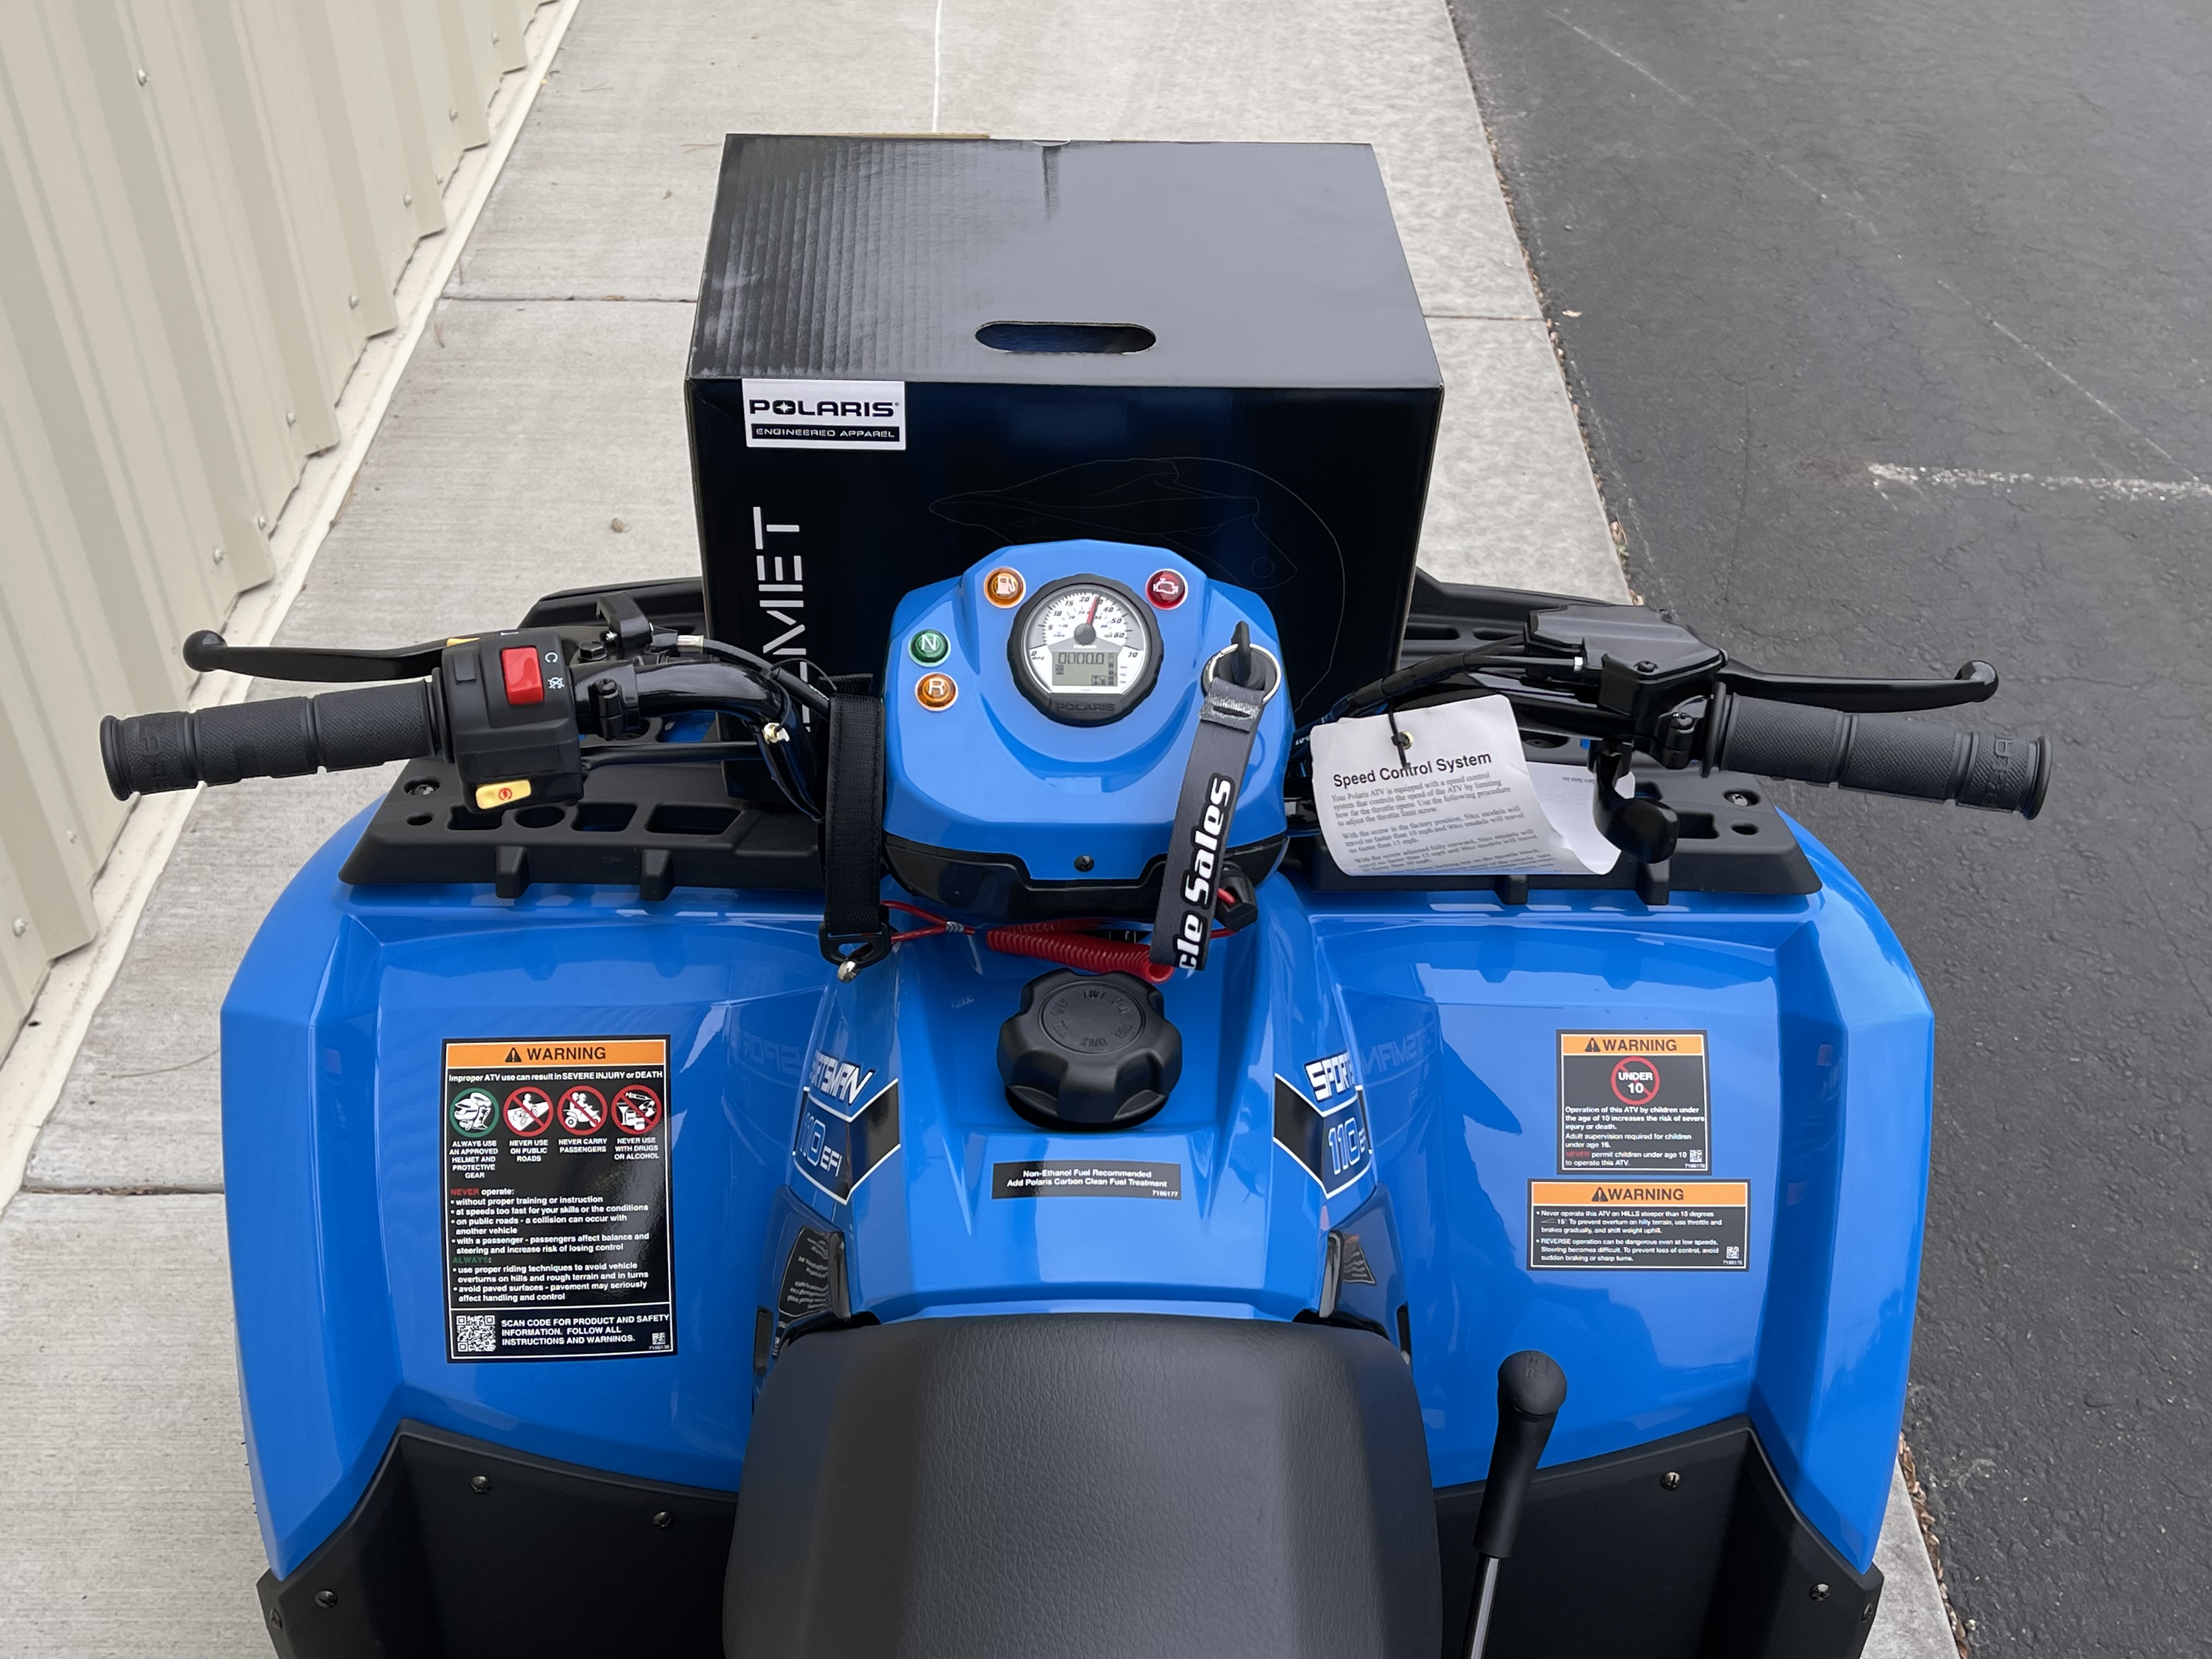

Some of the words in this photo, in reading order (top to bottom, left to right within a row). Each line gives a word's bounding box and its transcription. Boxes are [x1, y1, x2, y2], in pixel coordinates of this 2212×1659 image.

[749, 399, 895, 417] POLARIS
[756, 428, 836, 437] ENGINEERED
[753, 506, 812, 732] MET
[921, 634, 938, 651] N
[928, 678, 944, 696] R
[1057, 702, 1116, 712] POLARIS
[1333, 770, 1376, 789] Speed
[1379, 760, 1433, 780] Control
[1436, 753, 1492, 773] System
[1347, 792, 1369, 800] Polaris
[1371, 788, 1385, 797] ATV
[1394, 783, 1423, 794] equipped
[1466, 771, 1491, 781] control
[1184, 777, 1233, 906] Sales
[1602, 1039, 1677, 1052] WARNING
[527, 1047, 606, 1060] WARNING
[448, 1074, 483, 1083] Improper
[1618, 1072, 1653, 1081] UNDER
[1628, 1083, 1644, 1094] 10
[1565, 1106, 1600, 1115] Operation
[1640, 1106, 1649, 1115] by
[1565, 1123, 1584, 1132] injury
[1584, 1133, 1623, 1142] supervision
[1624, 1133, 1652, 1142] required
[1328, 1116, 1361, 1176] 110
[1592, 1151, 1613, 1160] permit
[820, 1145, 843, 1177] EFI
[1573, 1159, 1600, 1167] operate
[1023, 1170, 1072, 1178] Non-Ethanol
[1073, 1170, 1091, 1178] Fuel
[1007, 1179, 1024, 1187] Add
[1025, 1179, 1053, 1187] Polaris
[1054, 1179, 1084, 1187] Carbon
[1085, 1179, 1108, 1187] Clean
[1109, 1179, 1127, 1187] Fuel
[1128, 1179, 1167, 1188] Treatment
[481, 1188, 514, 1197] operate:
[1607, 1188, 1684, 1201] WARNING
[516, 1197, 547, 1206] training
[466, 1207, 495, 1217] speeds
[501, 1319, 525, 1327] SCAN
[573, 1316, 614, 1324] PRODUCT
[617, 1315, 635, 1323] AND
[636, 1314, 670, 1322] SAFETY
[501, 1328, 562, 1336] INFORMATION.
[502, 1337, 565, 1346] INSTRUCTIONS
[586, 1335, 635, 1343] WARNINGS.
